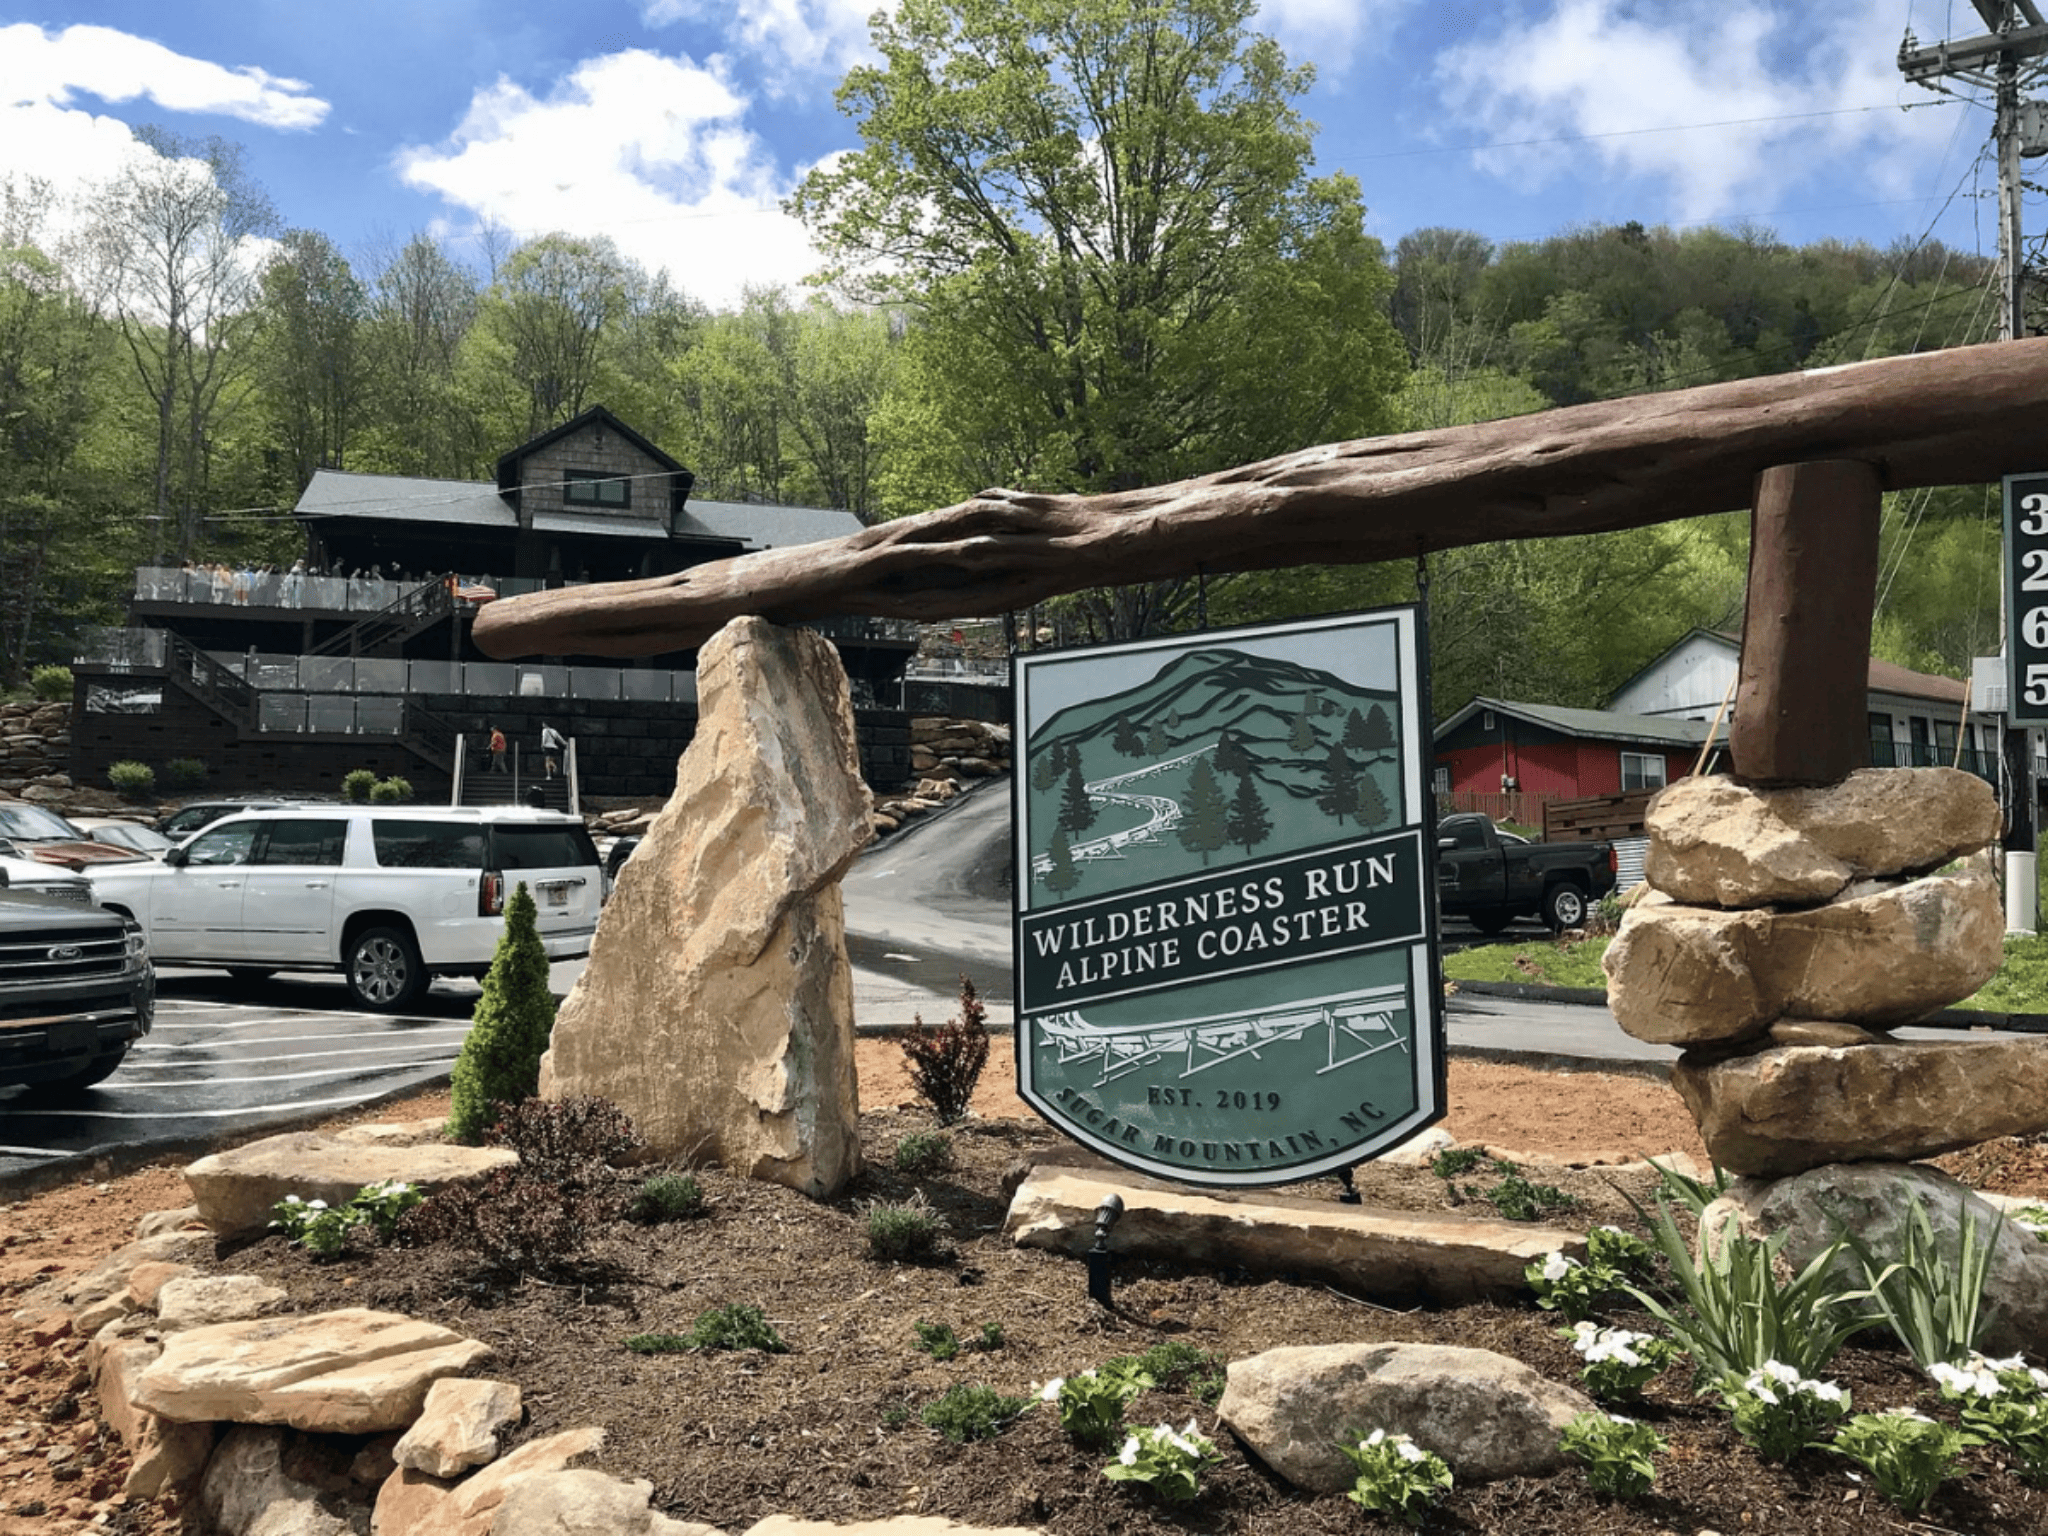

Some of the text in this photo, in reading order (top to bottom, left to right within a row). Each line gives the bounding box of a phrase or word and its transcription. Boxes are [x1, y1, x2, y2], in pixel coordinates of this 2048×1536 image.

[1032, 853, 1397, 958] WILDERNESS RUN
[1055, 901, 1370, 989] ALPINE COASTER
[1055, 1087, 1386, 1162] SUGAR MOUNTAIN, NC
[1147, 1086, 1281, 1111] EST. 2019
